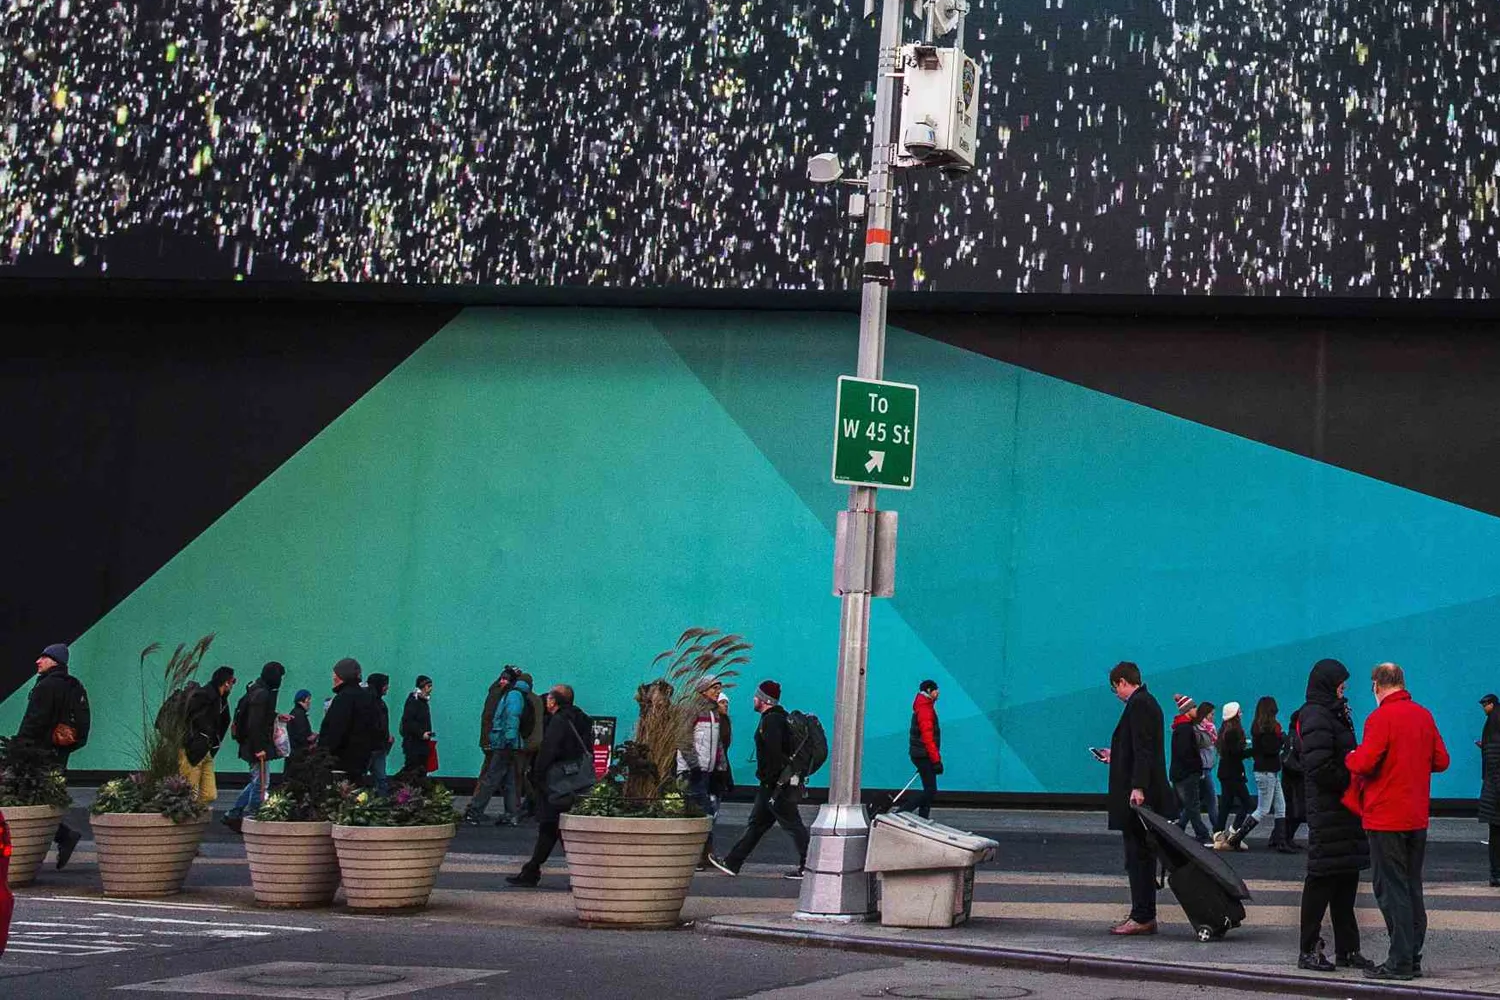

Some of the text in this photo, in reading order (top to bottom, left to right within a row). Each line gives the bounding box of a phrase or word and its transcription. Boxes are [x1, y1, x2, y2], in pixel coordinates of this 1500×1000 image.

[868, 393, 889, 414] To
[843, 418, 911, 445] W 45 St
